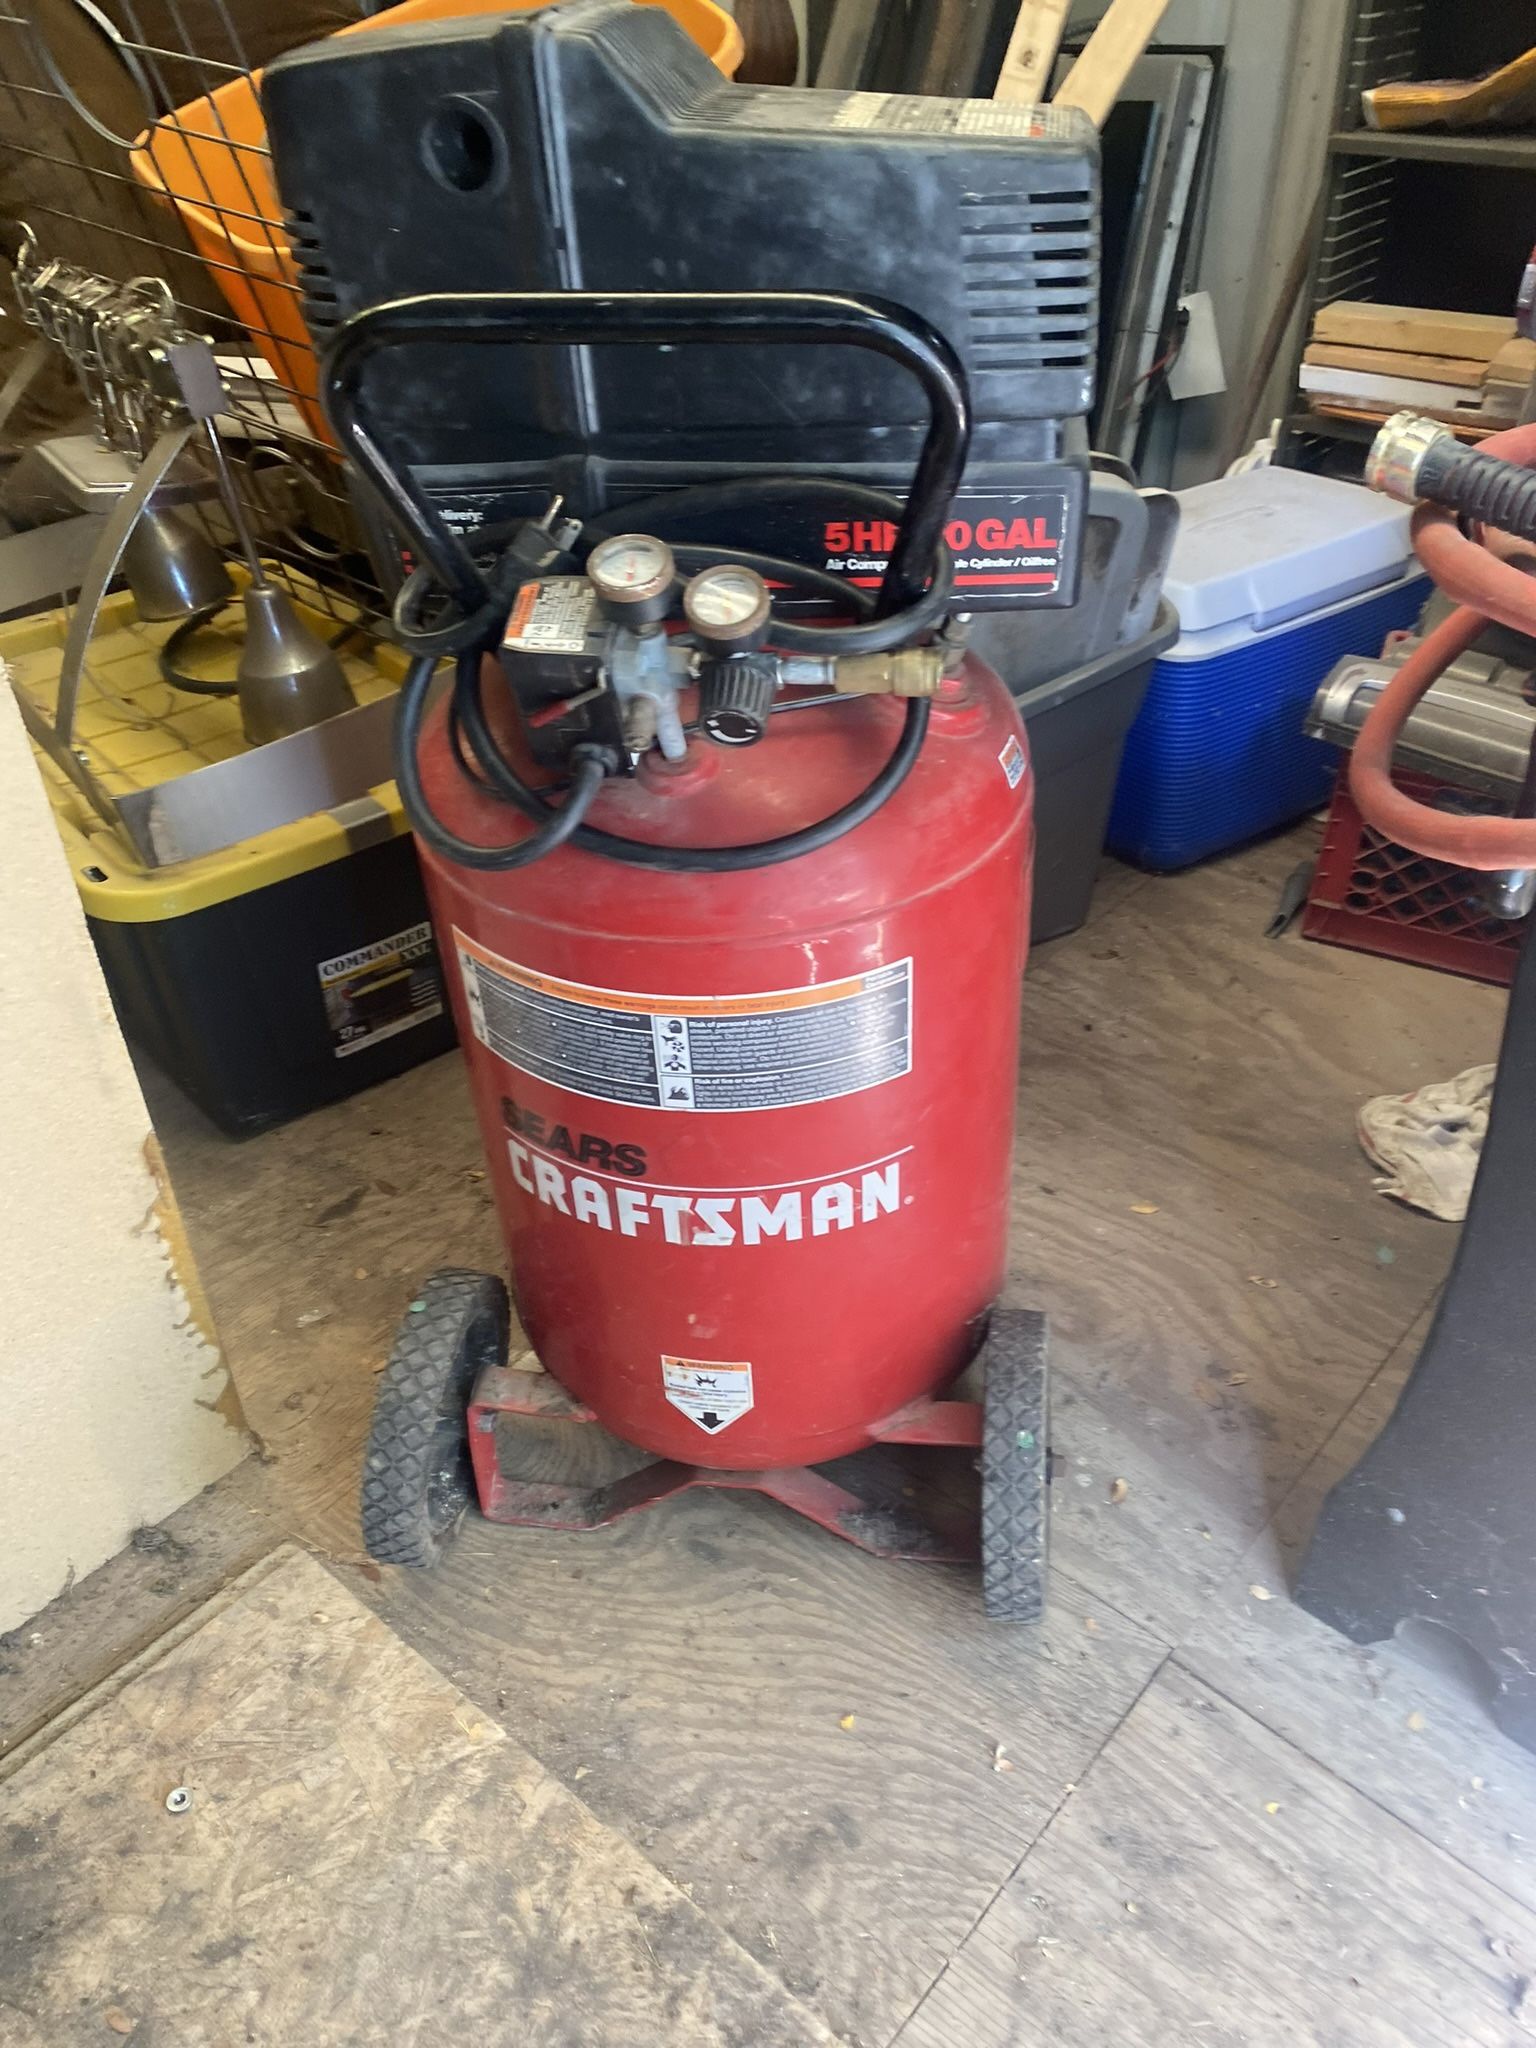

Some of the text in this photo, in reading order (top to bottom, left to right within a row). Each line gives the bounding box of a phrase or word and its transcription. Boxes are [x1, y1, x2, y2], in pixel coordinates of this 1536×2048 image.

[975, 517, 1057, 550] GAL
[825, 558, 846, 570] Air
[846, 558, 889, 572] Comp
[322, 926, 427, 977] COMMANDER
[502, 1095, 648, 1178] SEARS
